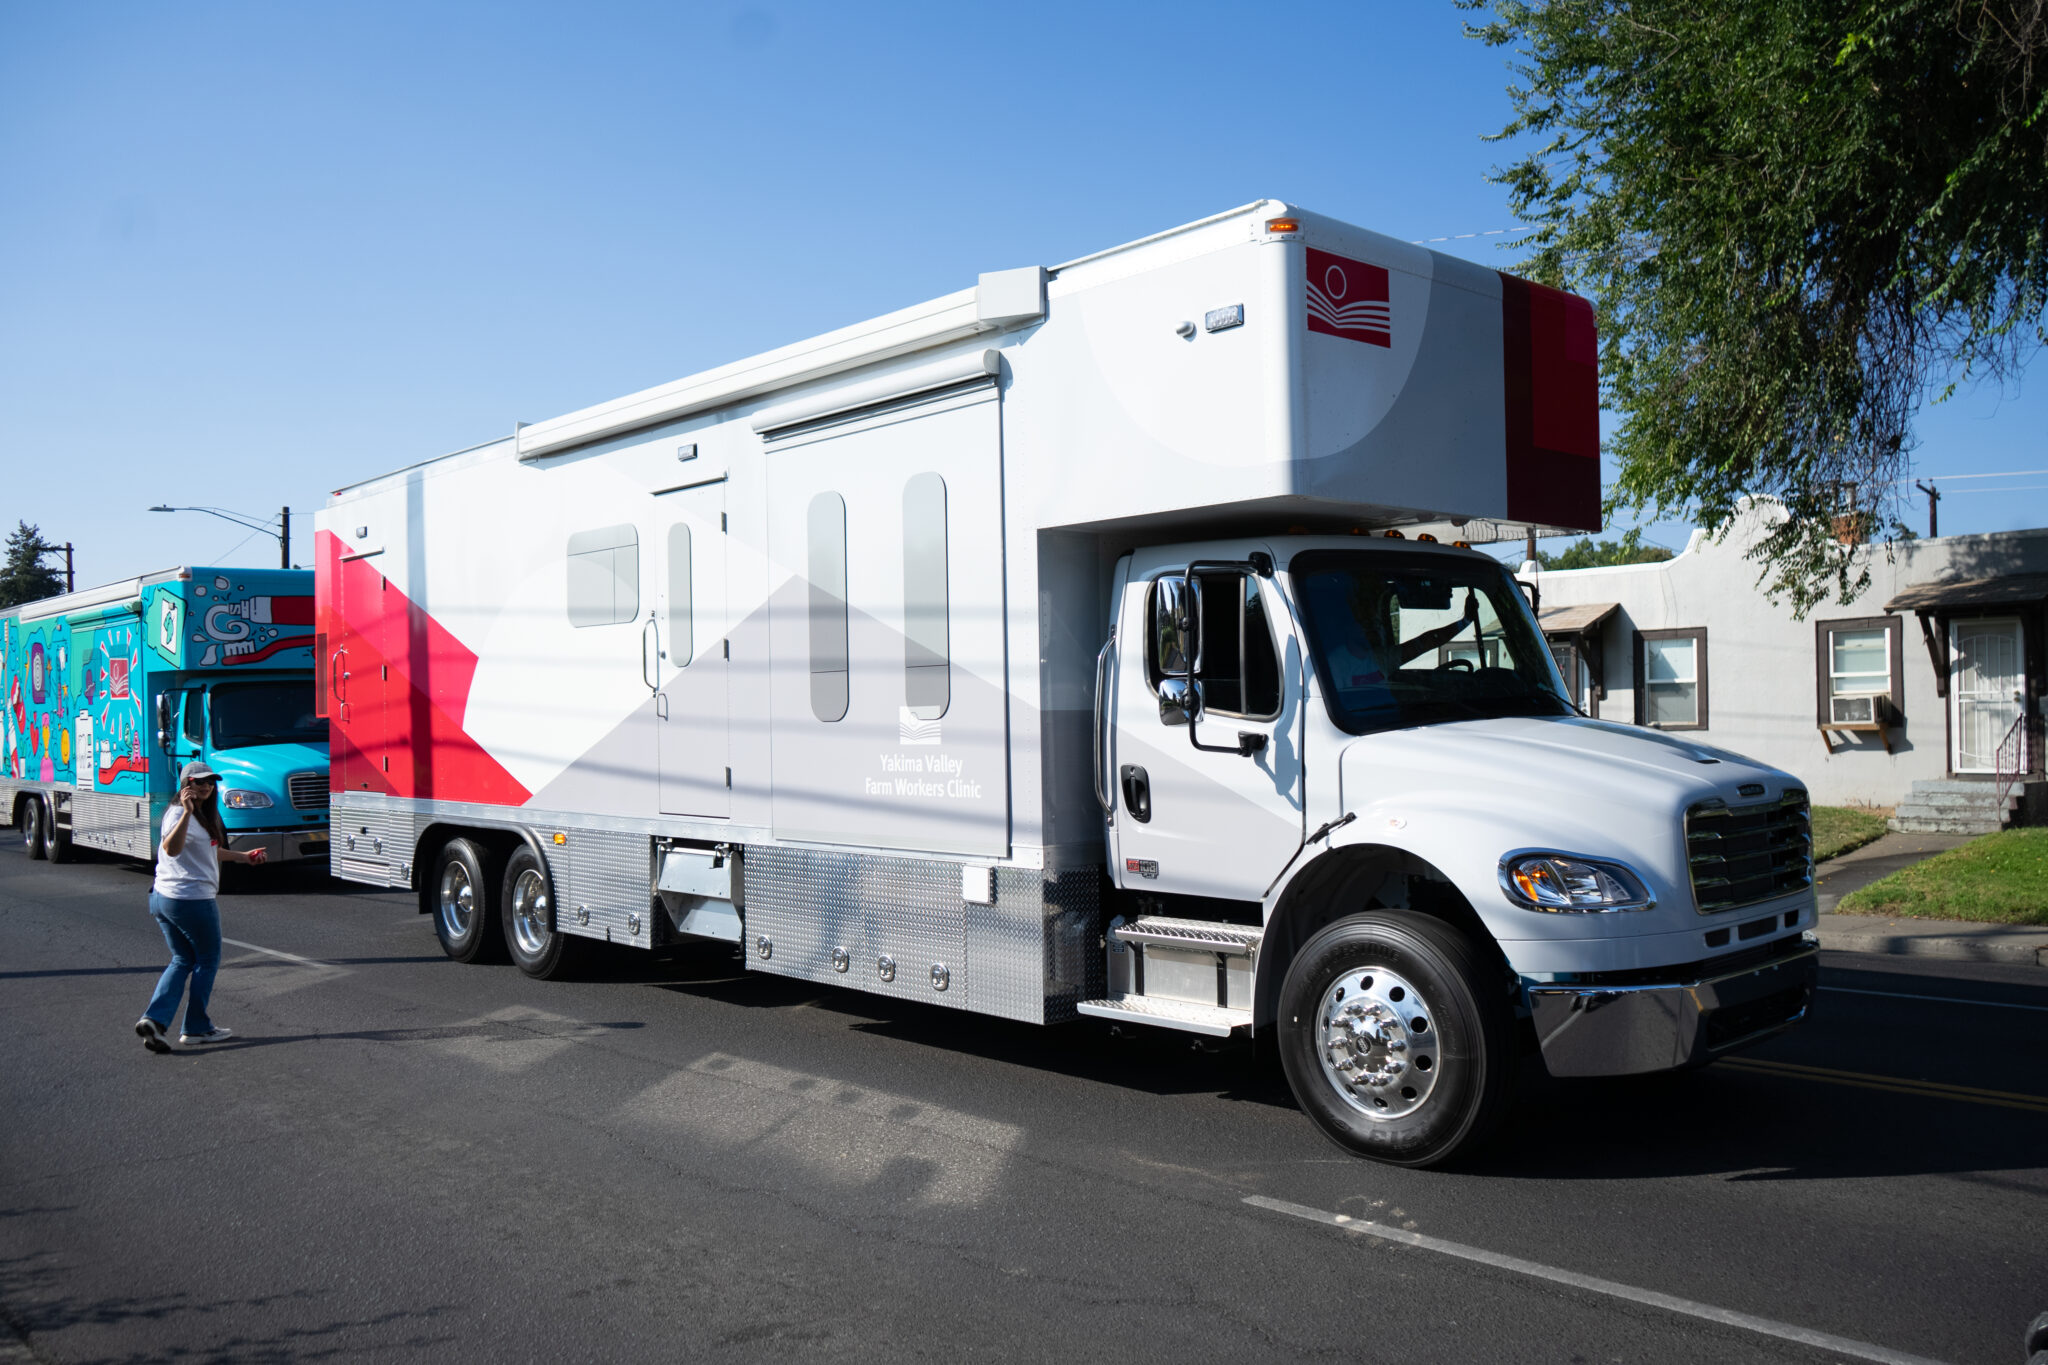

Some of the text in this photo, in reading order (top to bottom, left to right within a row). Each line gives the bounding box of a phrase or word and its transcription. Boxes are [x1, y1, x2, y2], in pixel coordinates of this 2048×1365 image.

[880, 754, 963, 777] Yakima Valley
[865, 777, 982, 799] Farm Workers Clinic
